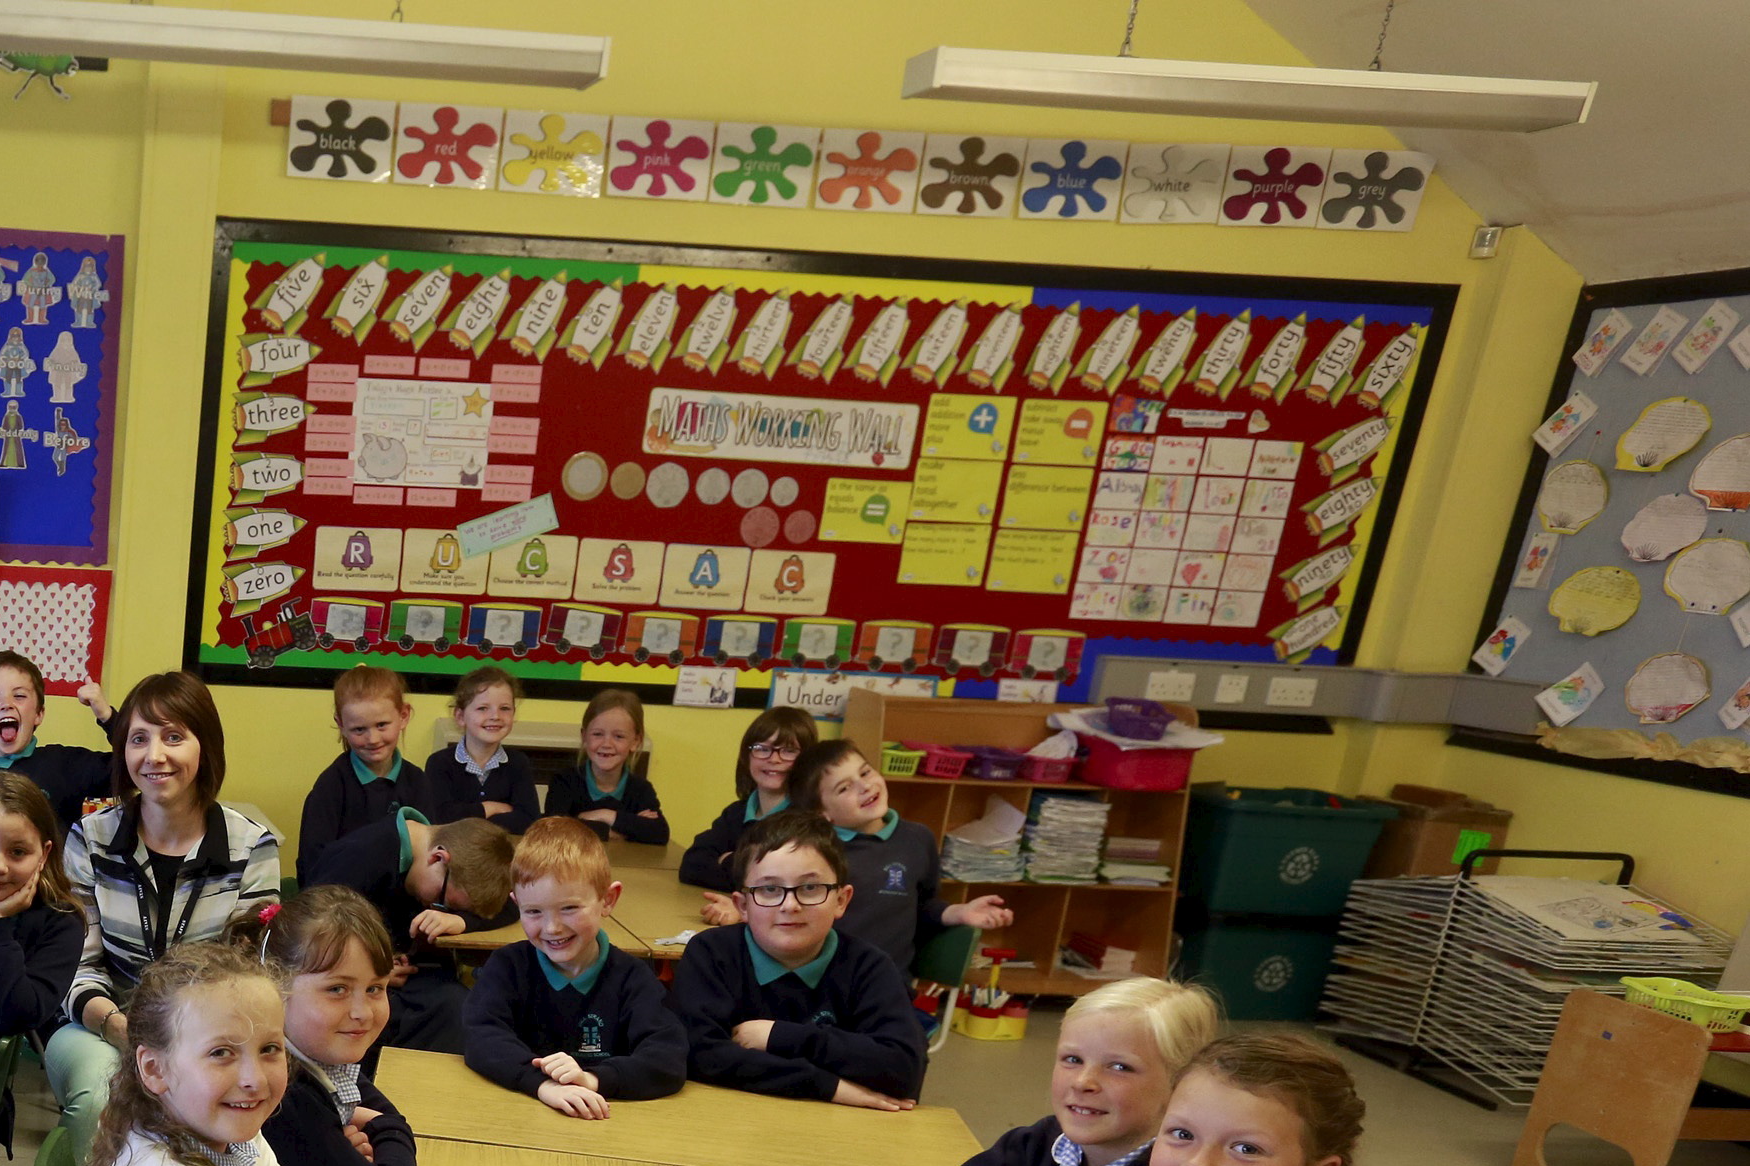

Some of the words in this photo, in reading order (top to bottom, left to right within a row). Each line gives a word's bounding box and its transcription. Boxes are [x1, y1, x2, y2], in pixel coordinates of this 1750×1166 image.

[320, 135, 356, 150] black
[435, 142, 457, 156] red
[529, 146, 574, 162] yellow
[643, 152, 671, 169] pink
[743, 158, 781, 176] green
[846, 166, 886, 181] orange
[950, 171, 989, 185] brown
[1057, 174, 1086, 189] blue
[1152, 178, 1190, 193] white
[1252, 180, 1295, 199] purple
[1359, 184, 1386, 200] grey
[17, 283, 62, 301] During
[67, 283, 109, 301] When
[277, 268, 311, 314] five
[352, 283, 376, 309] six
[403, 274, 446, 326] seven
[465, 280, 502, 331] eight
[526, 288, 558, 334] nine
[583, 302, 611, 336] ten
[639, 295, 673, 352] eleven
[697, 296, 730, 354] twelve
[752, 300, 785, 359] thirteen
[809, 304, 847, 363] fourteen
[867, 312, 899, 363] fifteen
[926, 312, 958, 363] sixteen
[1042, 315, 1073, 372] eighteen
[260, 342, 301, 371] four
[1098, 317, 1133, 374] nineteen
[1151, 320, 1191, 375] twenty
[1206, 325, 1243, 376] thirty
[1262, 329, 1300, 380] forty
[0, 356, 34, 370] Soon
[1318, 336, 1356, 381] fifty
[1371, 339, 1413, 389] sixty
[248, 404, 301, 425] three
[657, 395, 731, 444] MATHS
[736, 401, 843, 450] WORKING
[849, 408, 903, 454] WALL
[44, 433, 90, 449] Before
[1333, 420, 1387, 461] seventy
[266, 458, 271, 469] 2
[253, 468, 290, 485] two
[1321, 481, 1373, 520] eighty
[248, 520, 283, 538] one
[350, 542, 365, 564] R
[437, 545, 454, 566] U
[526, 550, 541, 571] C
[612, 554, 626, 576] S
[695, 560, 712, 582] A
[782, 565, 799, 587] C
[1297, 547, 1350, 587] ninety
[245, 572, 284, 594] zero
[370, 573, 394, 581] carefully
[1289, 612, 1337, 650] hundred
[787, 686, 840, 706] Under
